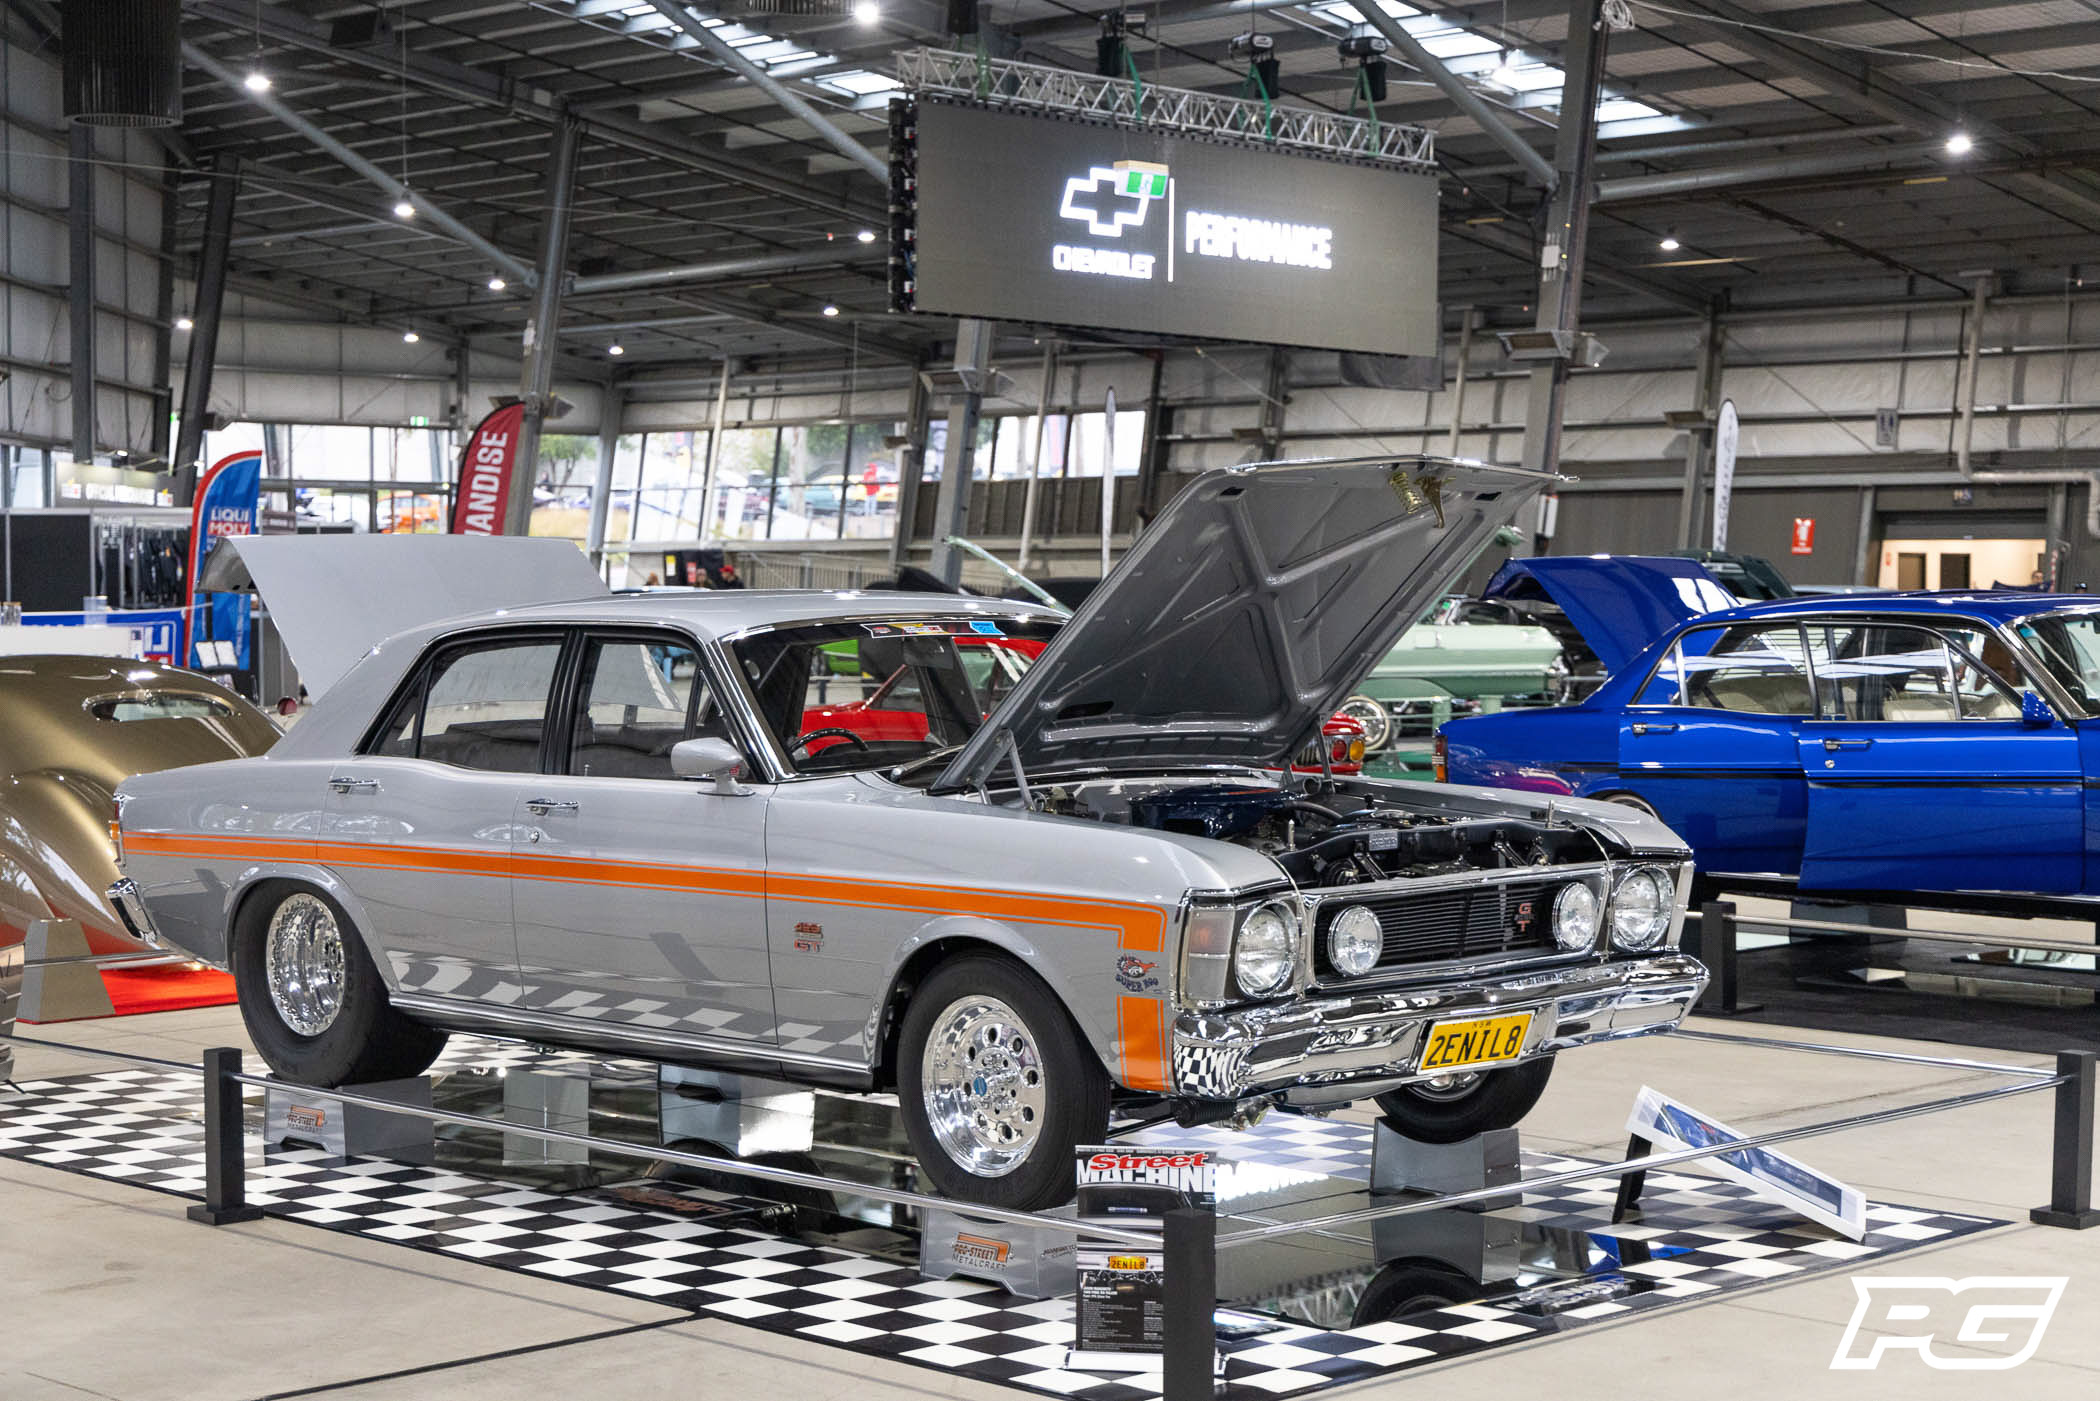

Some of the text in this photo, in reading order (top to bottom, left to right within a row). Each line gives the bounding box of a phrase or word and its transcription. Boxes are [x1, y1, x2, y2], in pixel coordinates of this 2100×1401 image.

[1186, 210, 1333, 270] PERFORMANCE
[464, 431, 509, 536] ANDISE
[210, 507, 250, 522] LIQUI
[209, 522, 249, 535] MOLY
[1472, 1021, 1493, 1029] NSW
[1090, 1152, 1208, 1171] Street
[951, 1253, 1007, 1271] METALCRAFT
